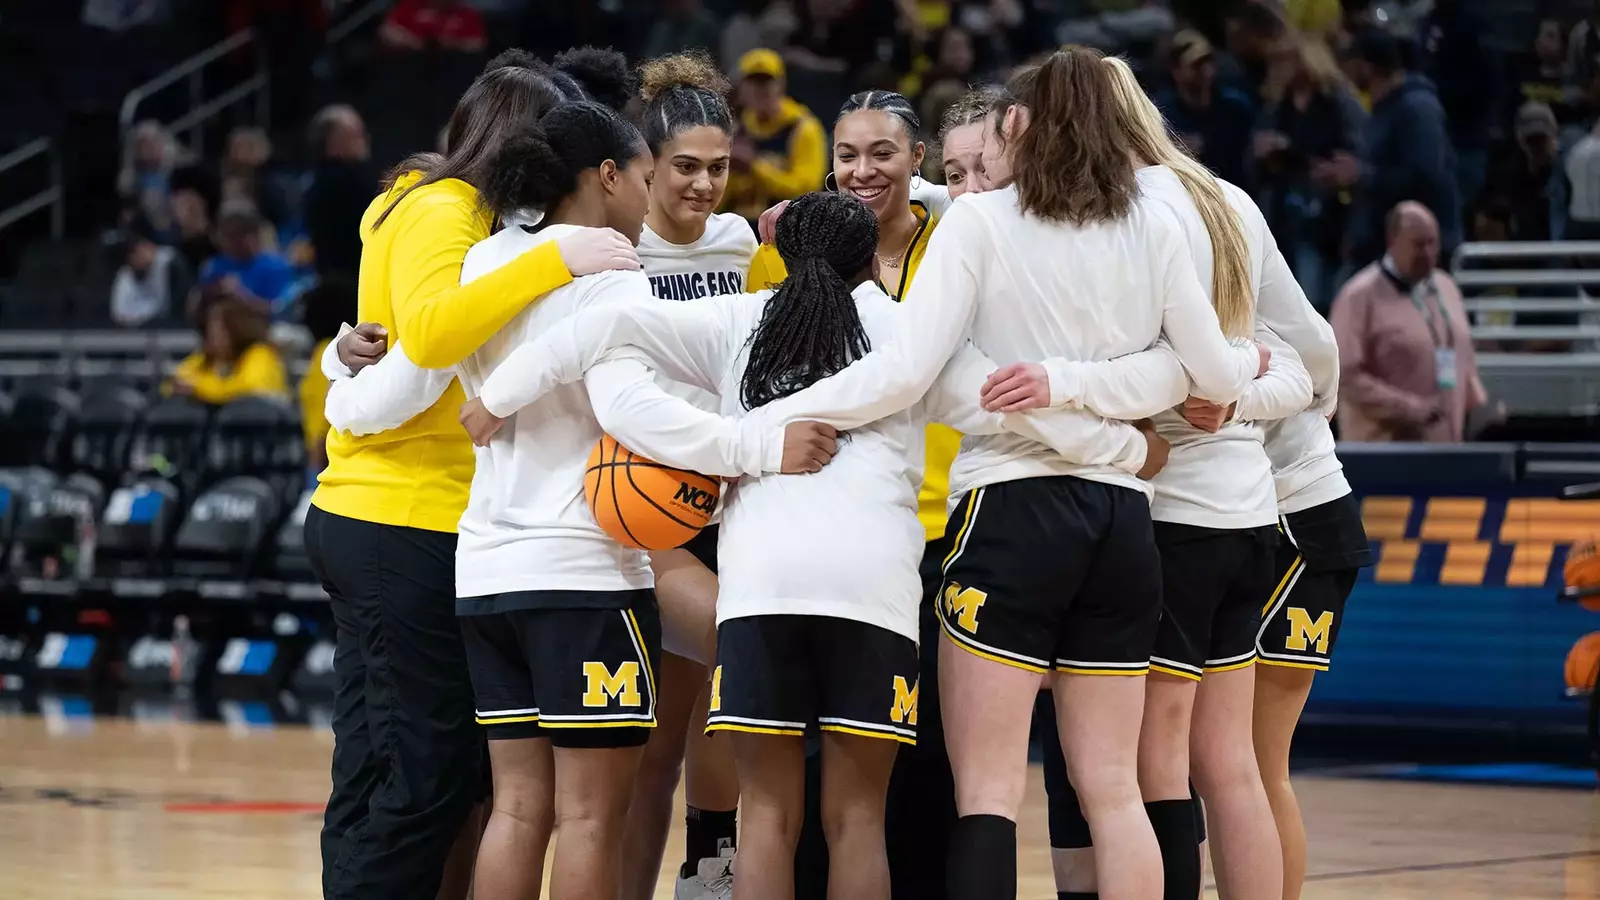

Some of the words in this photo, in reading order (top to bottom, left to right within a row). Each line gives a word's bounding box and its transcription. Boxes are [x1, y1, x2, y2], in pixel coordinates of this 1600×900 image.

[706, 271, 742, 298] EASY
[945, 581, 988, 634] M
[1285, 606, 1334, 654] M
[583, 661, 641, 707] M
[890, 675, 919, 725] M
